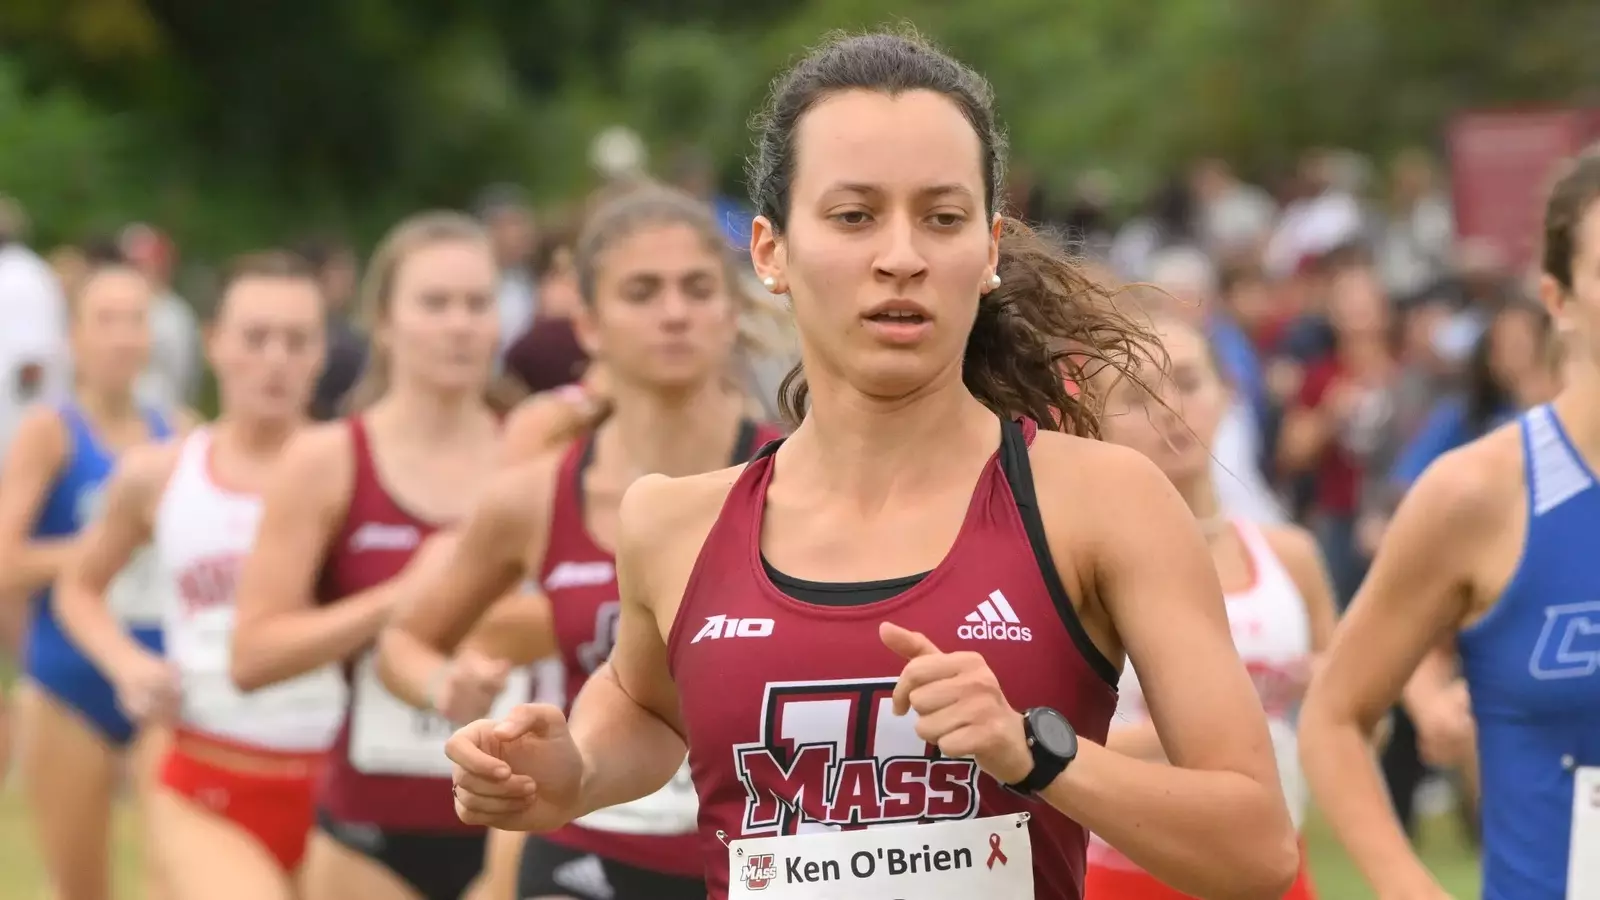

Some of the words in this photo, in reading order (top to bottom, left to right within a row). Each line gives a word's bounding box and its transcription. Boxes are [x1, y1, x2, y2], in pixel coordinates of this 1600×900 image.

[691, 614, 775, 644] A10
[957, 621, 1032, 641] adidas
[785, 856, 841, 884] Ken
[850, 844, 973, 879] O'Brien
